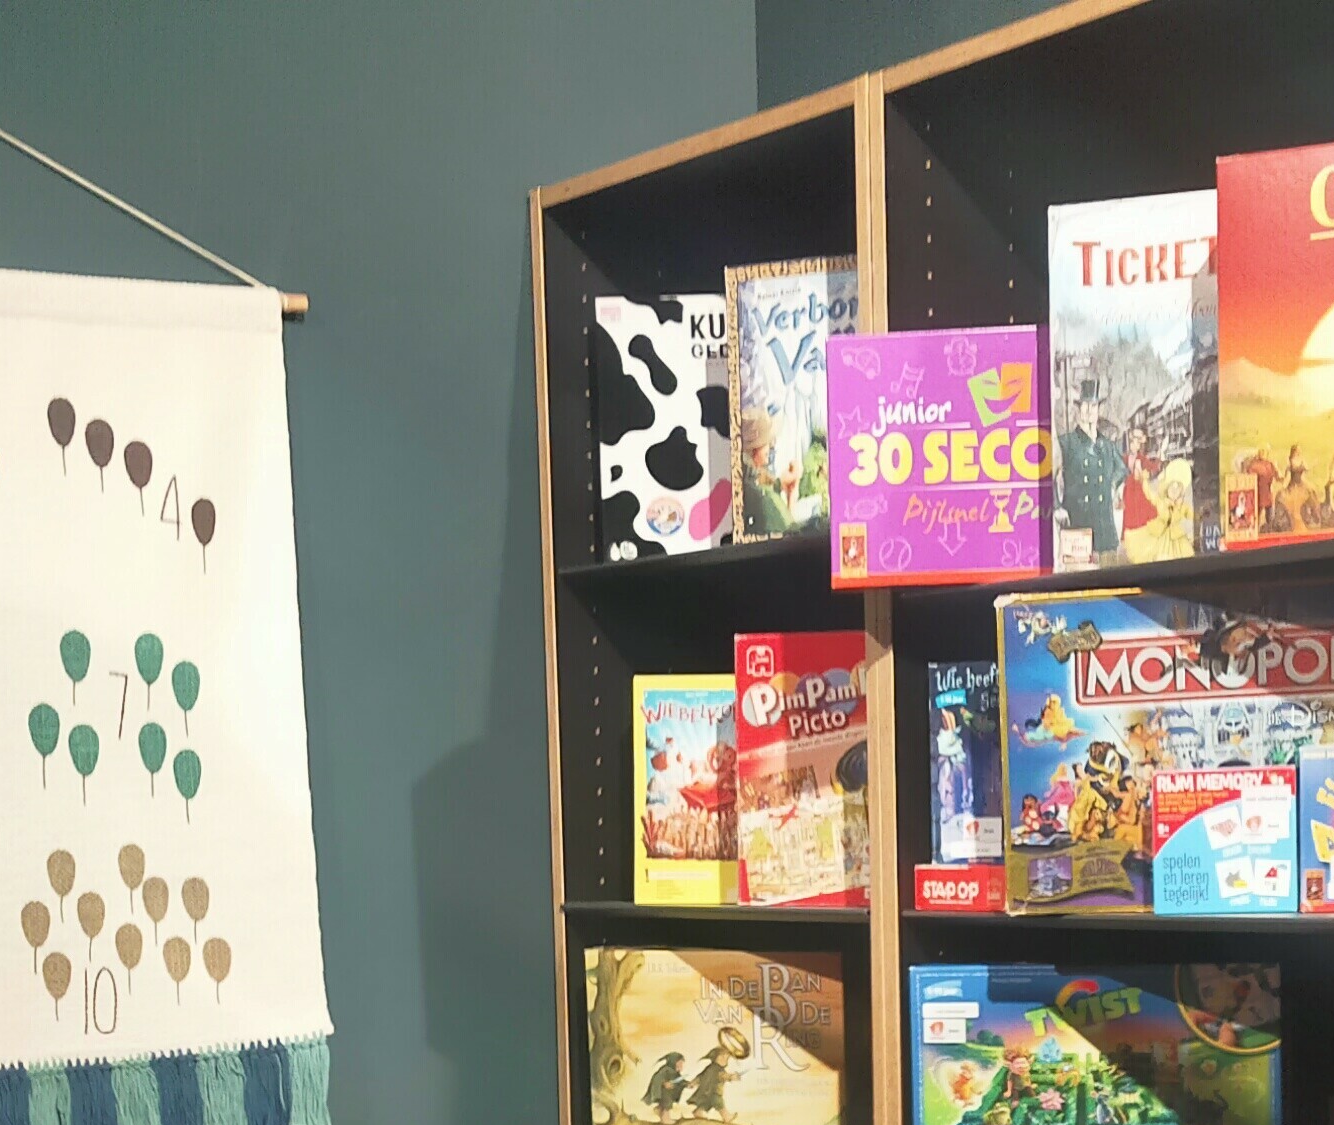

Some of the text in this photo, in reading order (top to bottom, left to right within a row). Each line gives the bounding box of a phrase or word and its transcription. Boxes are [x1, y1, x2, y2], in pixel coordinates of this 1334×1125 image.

[871, 396, 952, 438] junior
[848, 426, 1053, 487] 30 SECO
[159, 475, 181, 541] 4
[108, 670, 129, 741] 7
[788, 708, 847, 739] Picto
[1196, 772, 1264, 792] MEMORY
[1163, 853, 1201, 873] spelen
[1163, 868, 1210, 887] en leren
[923, 879, 980, 900] STAP OP
[82, 966, 119, 1037] 10
